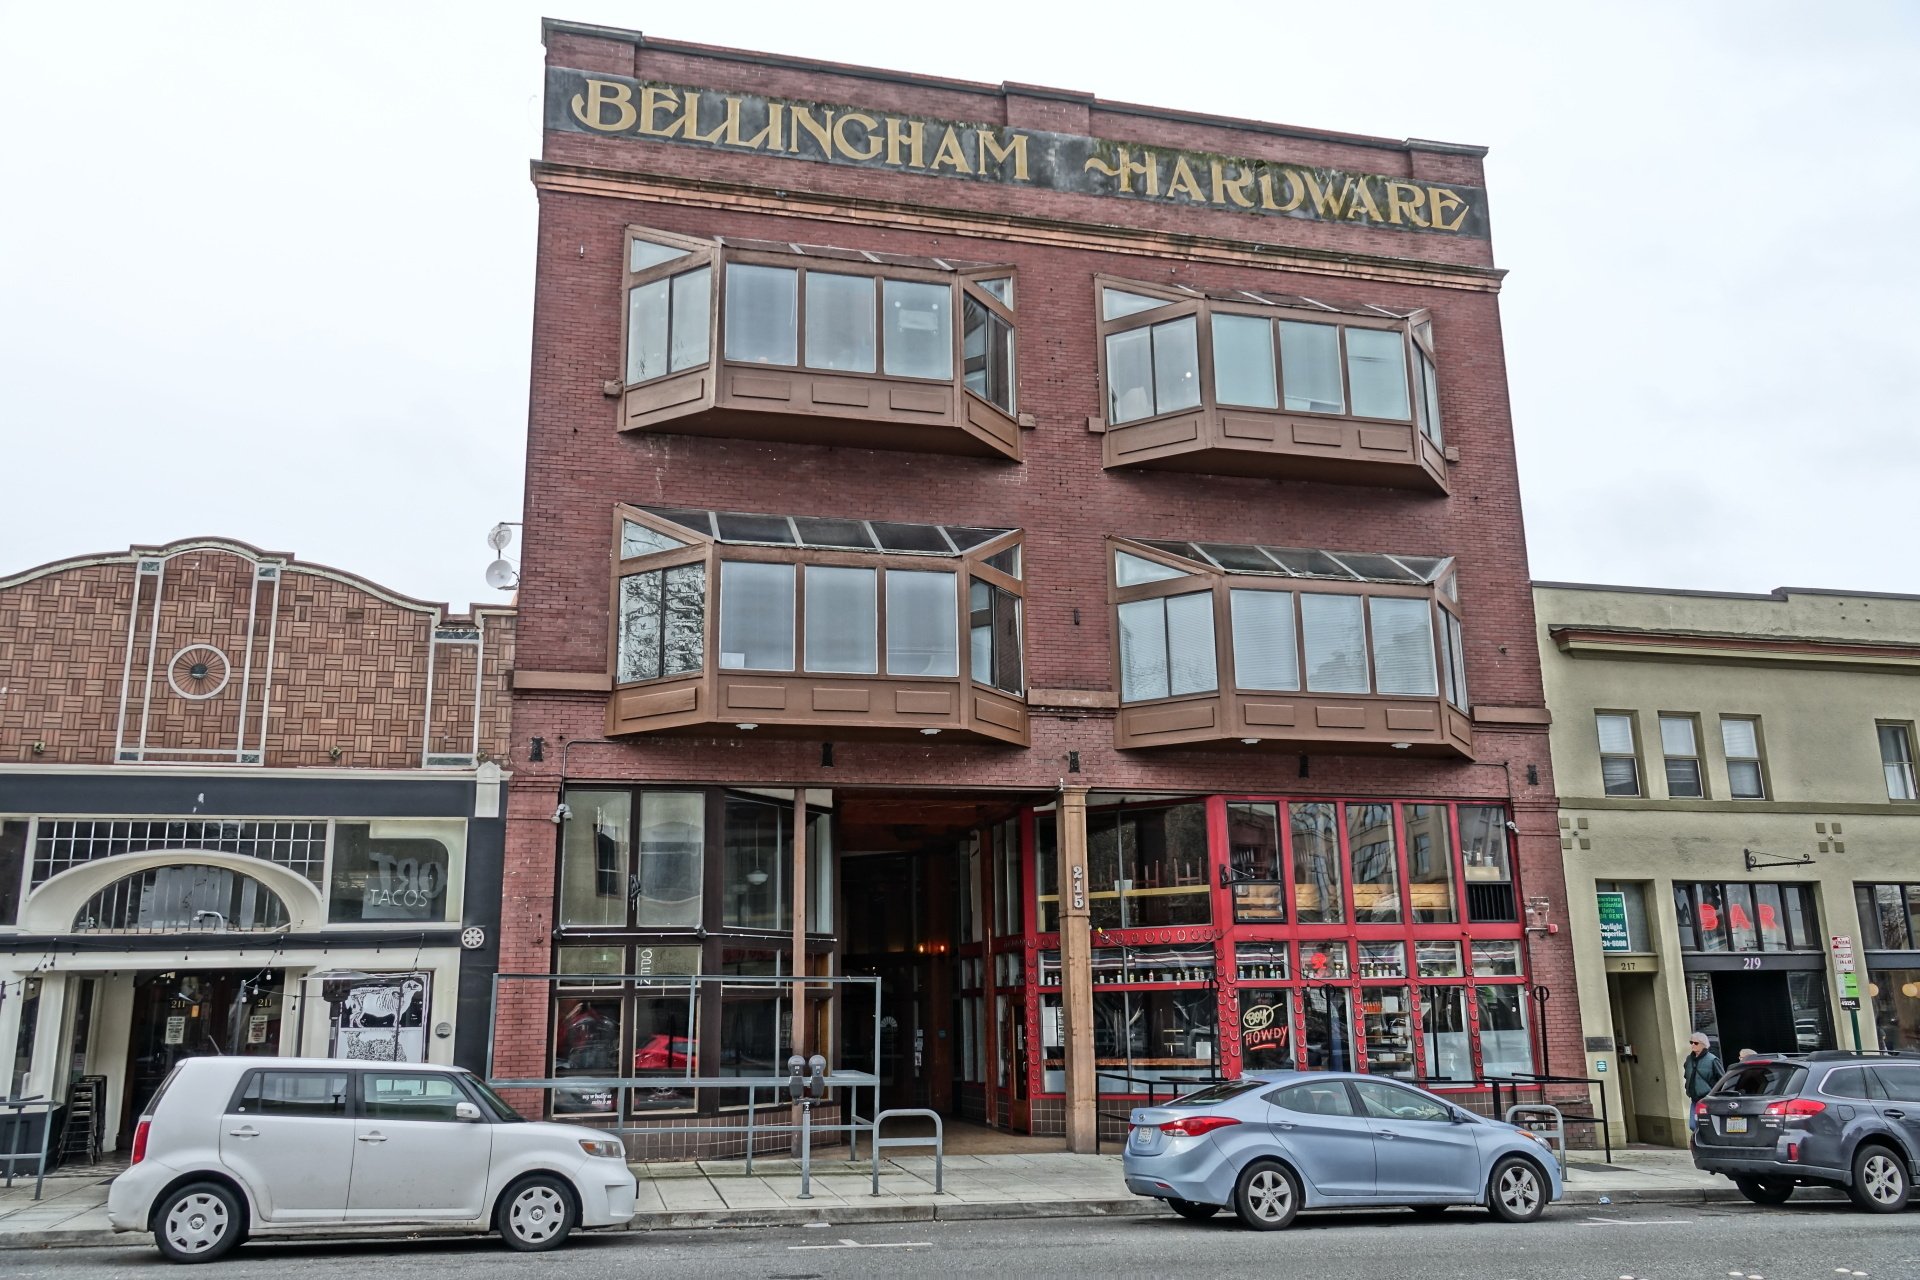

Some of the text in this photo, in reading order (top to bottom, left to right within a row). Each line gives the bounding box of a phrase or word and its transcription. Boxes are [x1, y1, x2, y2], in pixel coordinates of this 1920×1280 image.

[571, 78, 1470, 232] BELLINGHAM HARDWARE
[1073, 865, 1084, 908] 215
[370, 889, 428, 907] TACOS
[1698, 903, 1777, 931] BAR
[1620, 962, 1636, 971] 217
[1743, 957, 1761, 970] 219
[171, 999, 186, 1009] 211
[258, 998, 272, 1007] 211
[1245, 1025, 1288, 1047] HOWDY
